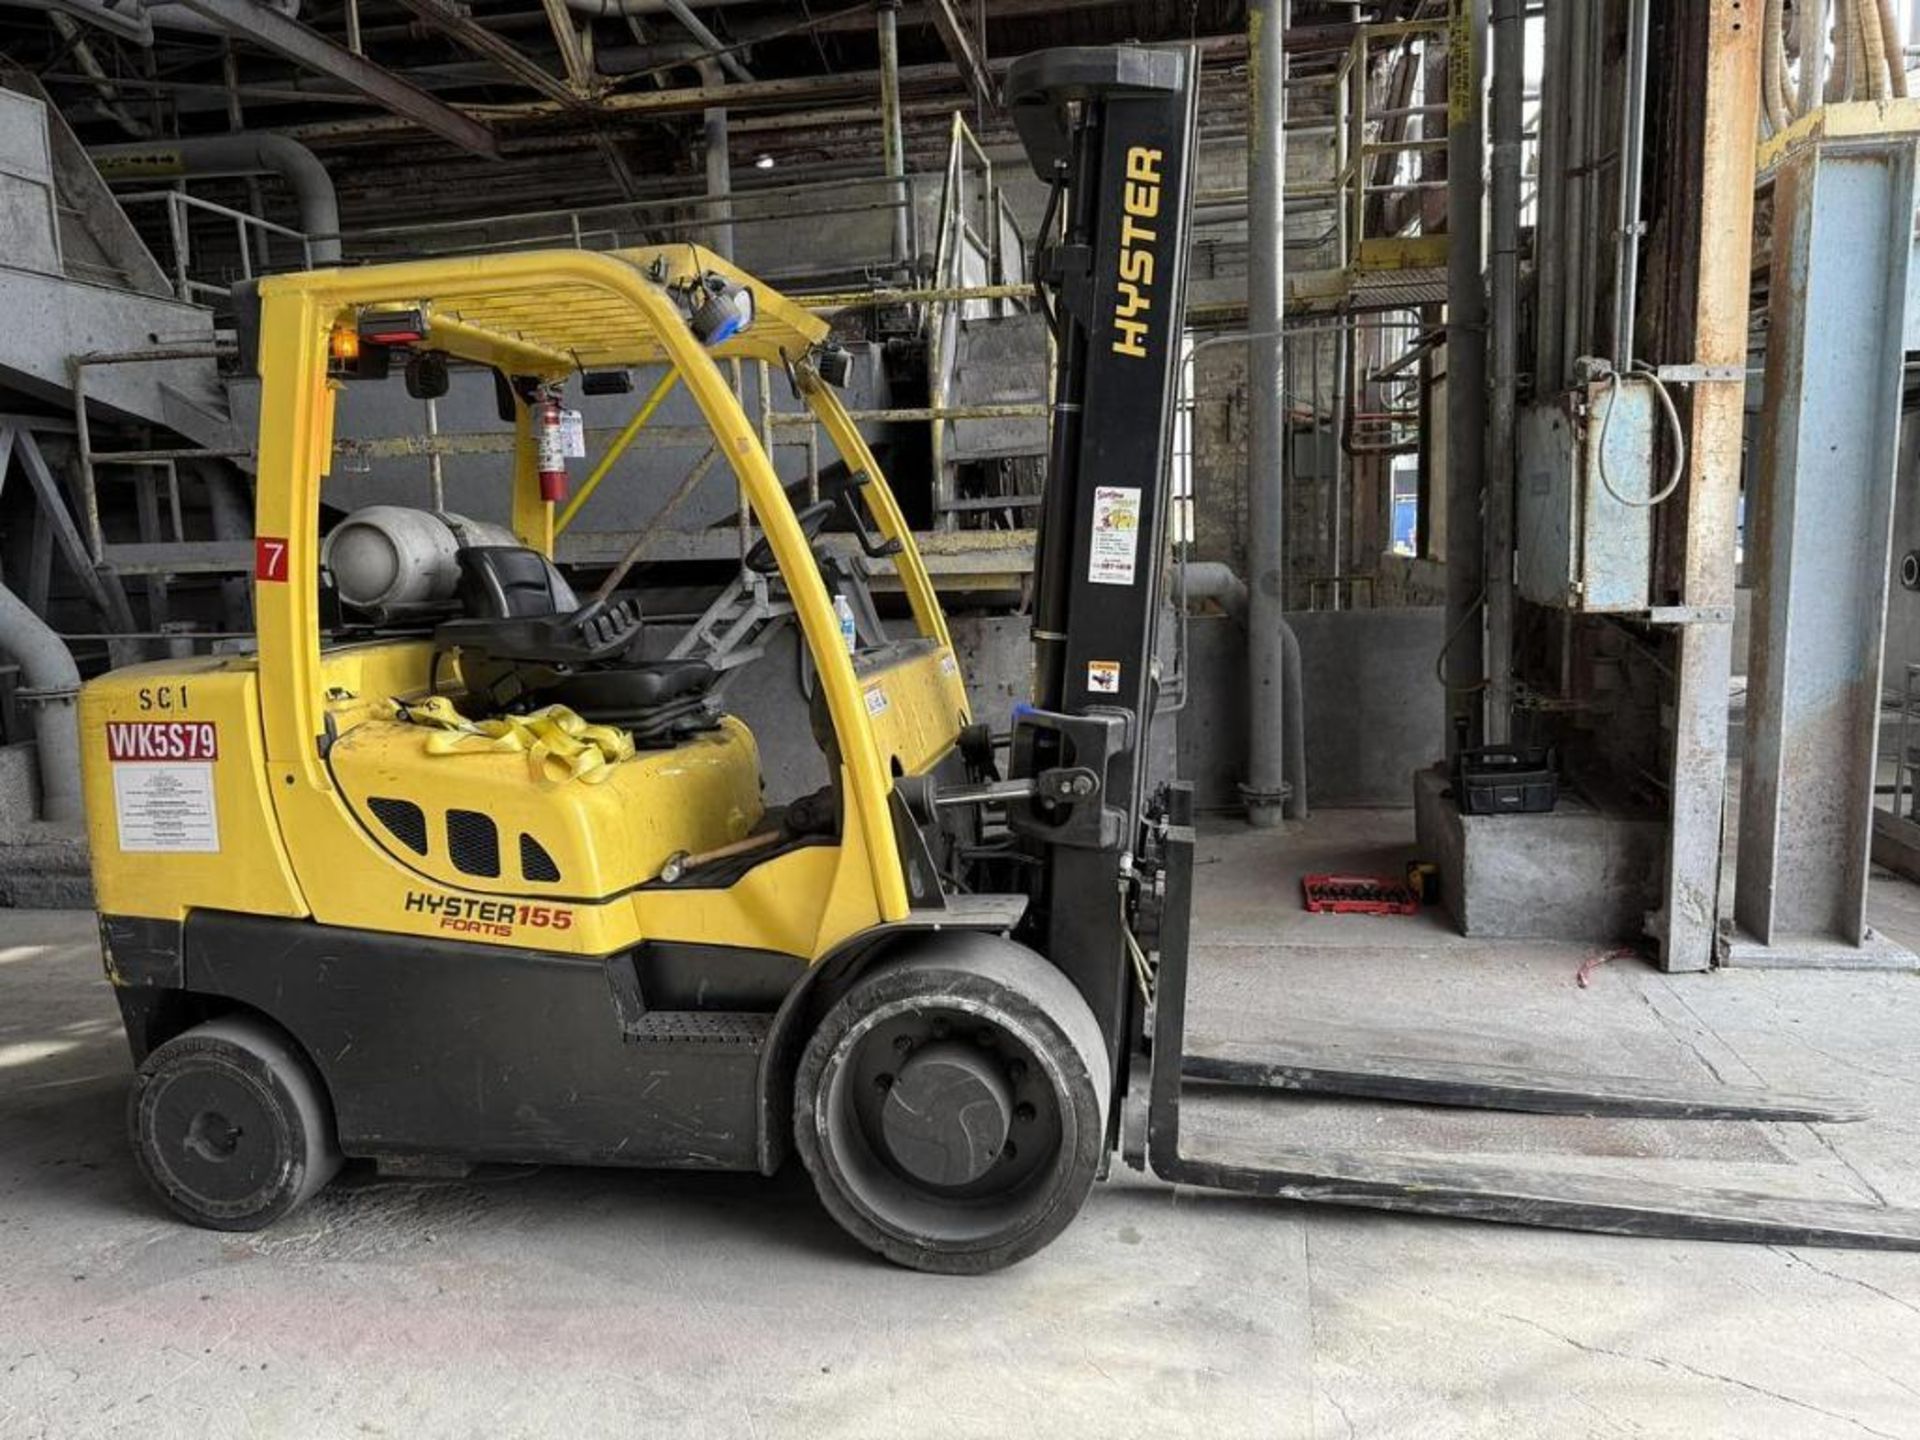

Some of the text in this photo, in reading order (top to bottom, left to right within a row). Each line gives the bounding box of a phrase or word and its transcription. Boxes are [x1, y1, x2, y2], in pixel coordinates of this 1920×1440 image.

[1112, 146, 1162, 358] HYSTER
[264, 543, 284, 577] 7
[110, 723, 215, 758] WK5S79
[405, 891, 574, 931] HYSTER 155
[440, 917, 513, 937] FORTIS
